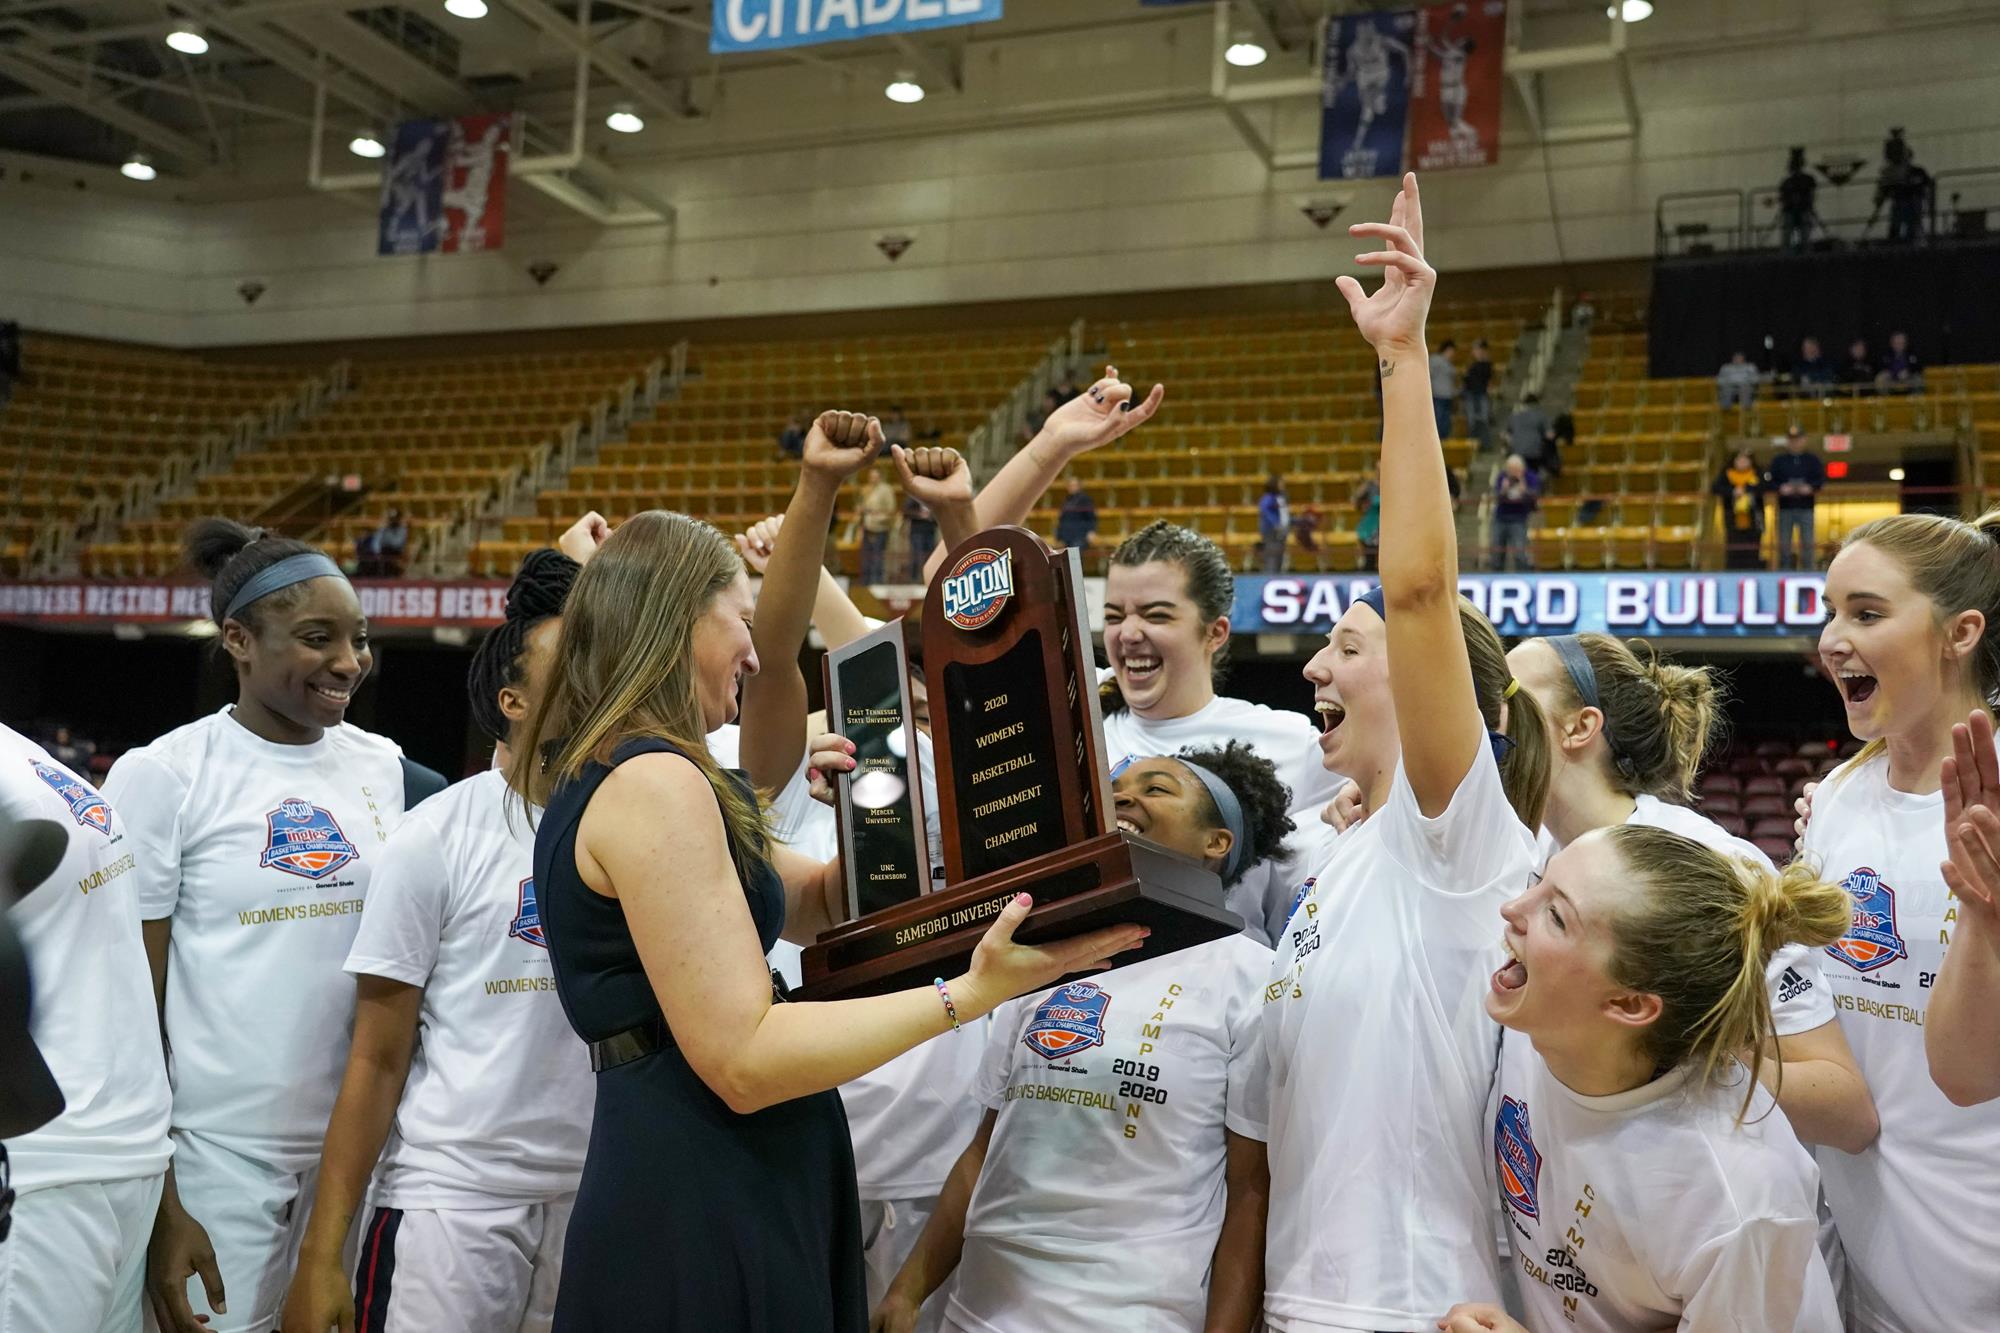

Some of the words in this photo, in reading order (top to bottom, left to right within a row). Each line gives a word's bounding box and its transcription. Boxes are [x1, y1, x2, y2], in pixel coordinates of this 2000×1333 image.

[944, 553, 1009, 618] SOCON
[865, 708, 897, 716] TENNESSEE
[984, 694, 1008, 712] 2020
[865, 716, 901, 724] UNIVERSITY
[976, 721, 1024, 749] WOMEN'S
[972, 753, 1036, 785] BASKETBALL
[870, 808, 895, 816] MERCER
[973, 784, 1042, 819] TOURNAMENT
[286, 829, 328, 843] ingles
[985, 822, 1038, 850] CHAMPION
[270, 843, 305, 858] BASKETBALL
[869, 873, 907, 881] GREENSBORO
[1847, 872, 1880, 894] SOCON
[238, 905, 307, 926] WOMEN'S
[309, 899, 364, 918] BASKETB
[895, 916, 949, 945] SAMFORD
[485, 977, 549, 995] WOMEN'S
[1778, 979, 1813, 1003] adidas
[1046, 1006, 1088, 1022] ingles
[1056, 1021, 1097, 1036] CHAMPIONSHIPS
[1047, 1063, 1070, 1073] General
[1071, 1066, 1088, 1075] Shale
[1112, 1058, 1160, 1082] 2019
[1036, 1084, 1117, 1111] BASKETBALL
[1119, 1081, 1168, 1105] 2020
[1554, 1273, 1599, 1298] 2020
